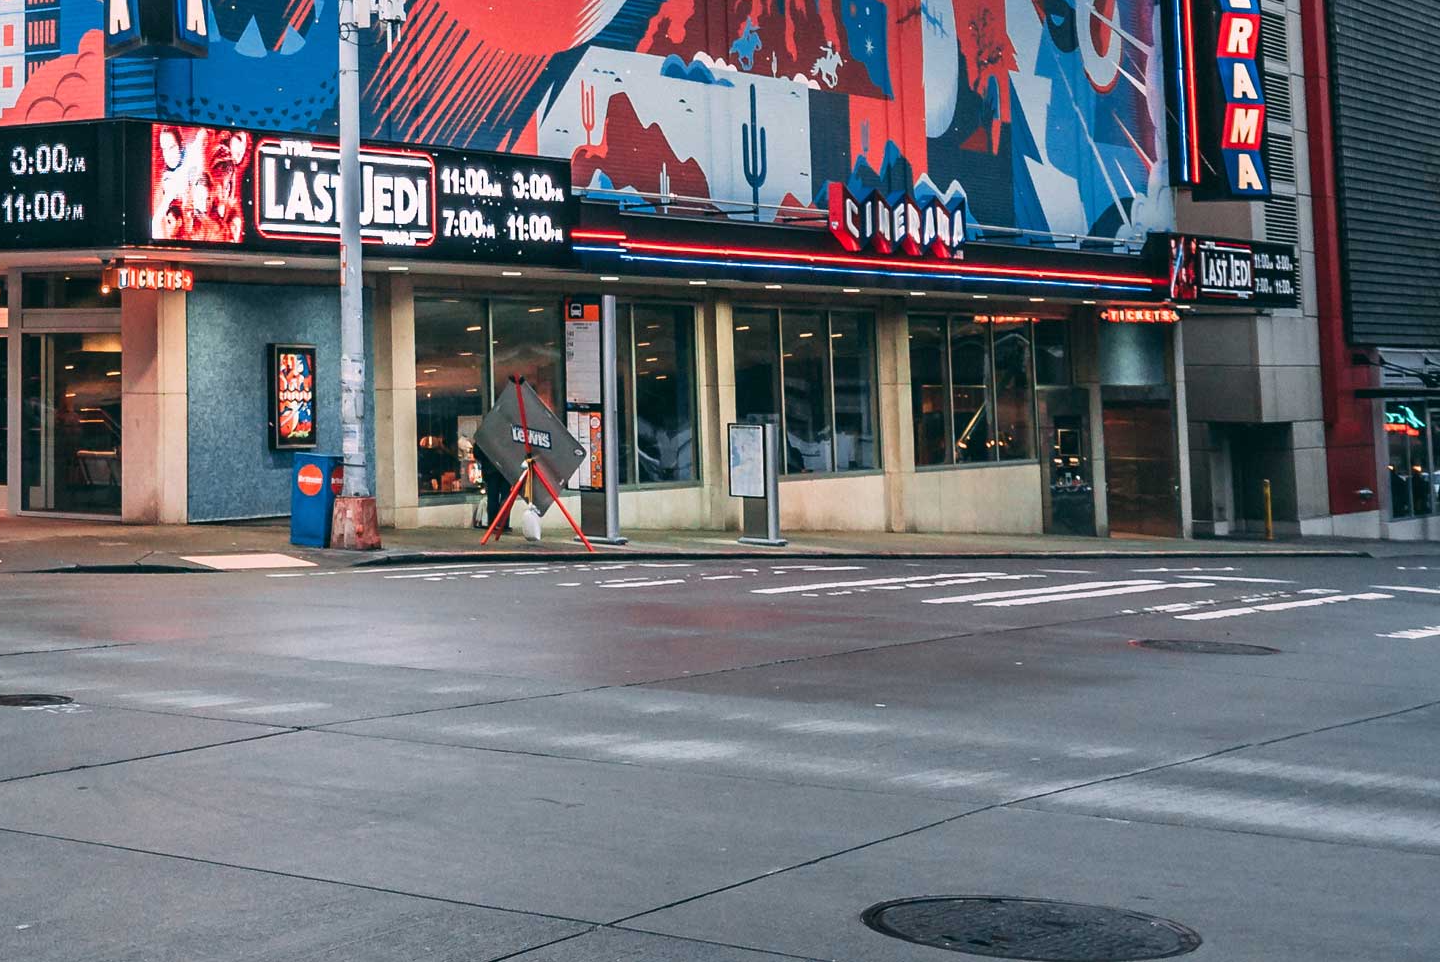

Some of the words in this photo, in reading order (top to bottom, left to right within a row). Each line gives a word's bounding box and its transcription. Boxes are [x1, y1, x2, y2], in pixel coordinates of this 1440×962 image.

[11, 143, 87, 176] 3:00PM
[2, 191, 85, 224] 11:00PM
[359, 165, 428, 227] JEDI
[845, 198, 965, 248] CINERAMA
[120, 268, 183, 289] TICKETS
[1201, 251, 1228, 287] LAST
[1229, 253, 1252, 288] JEDI
[1110, 309, 1171, 322] TICKETS
